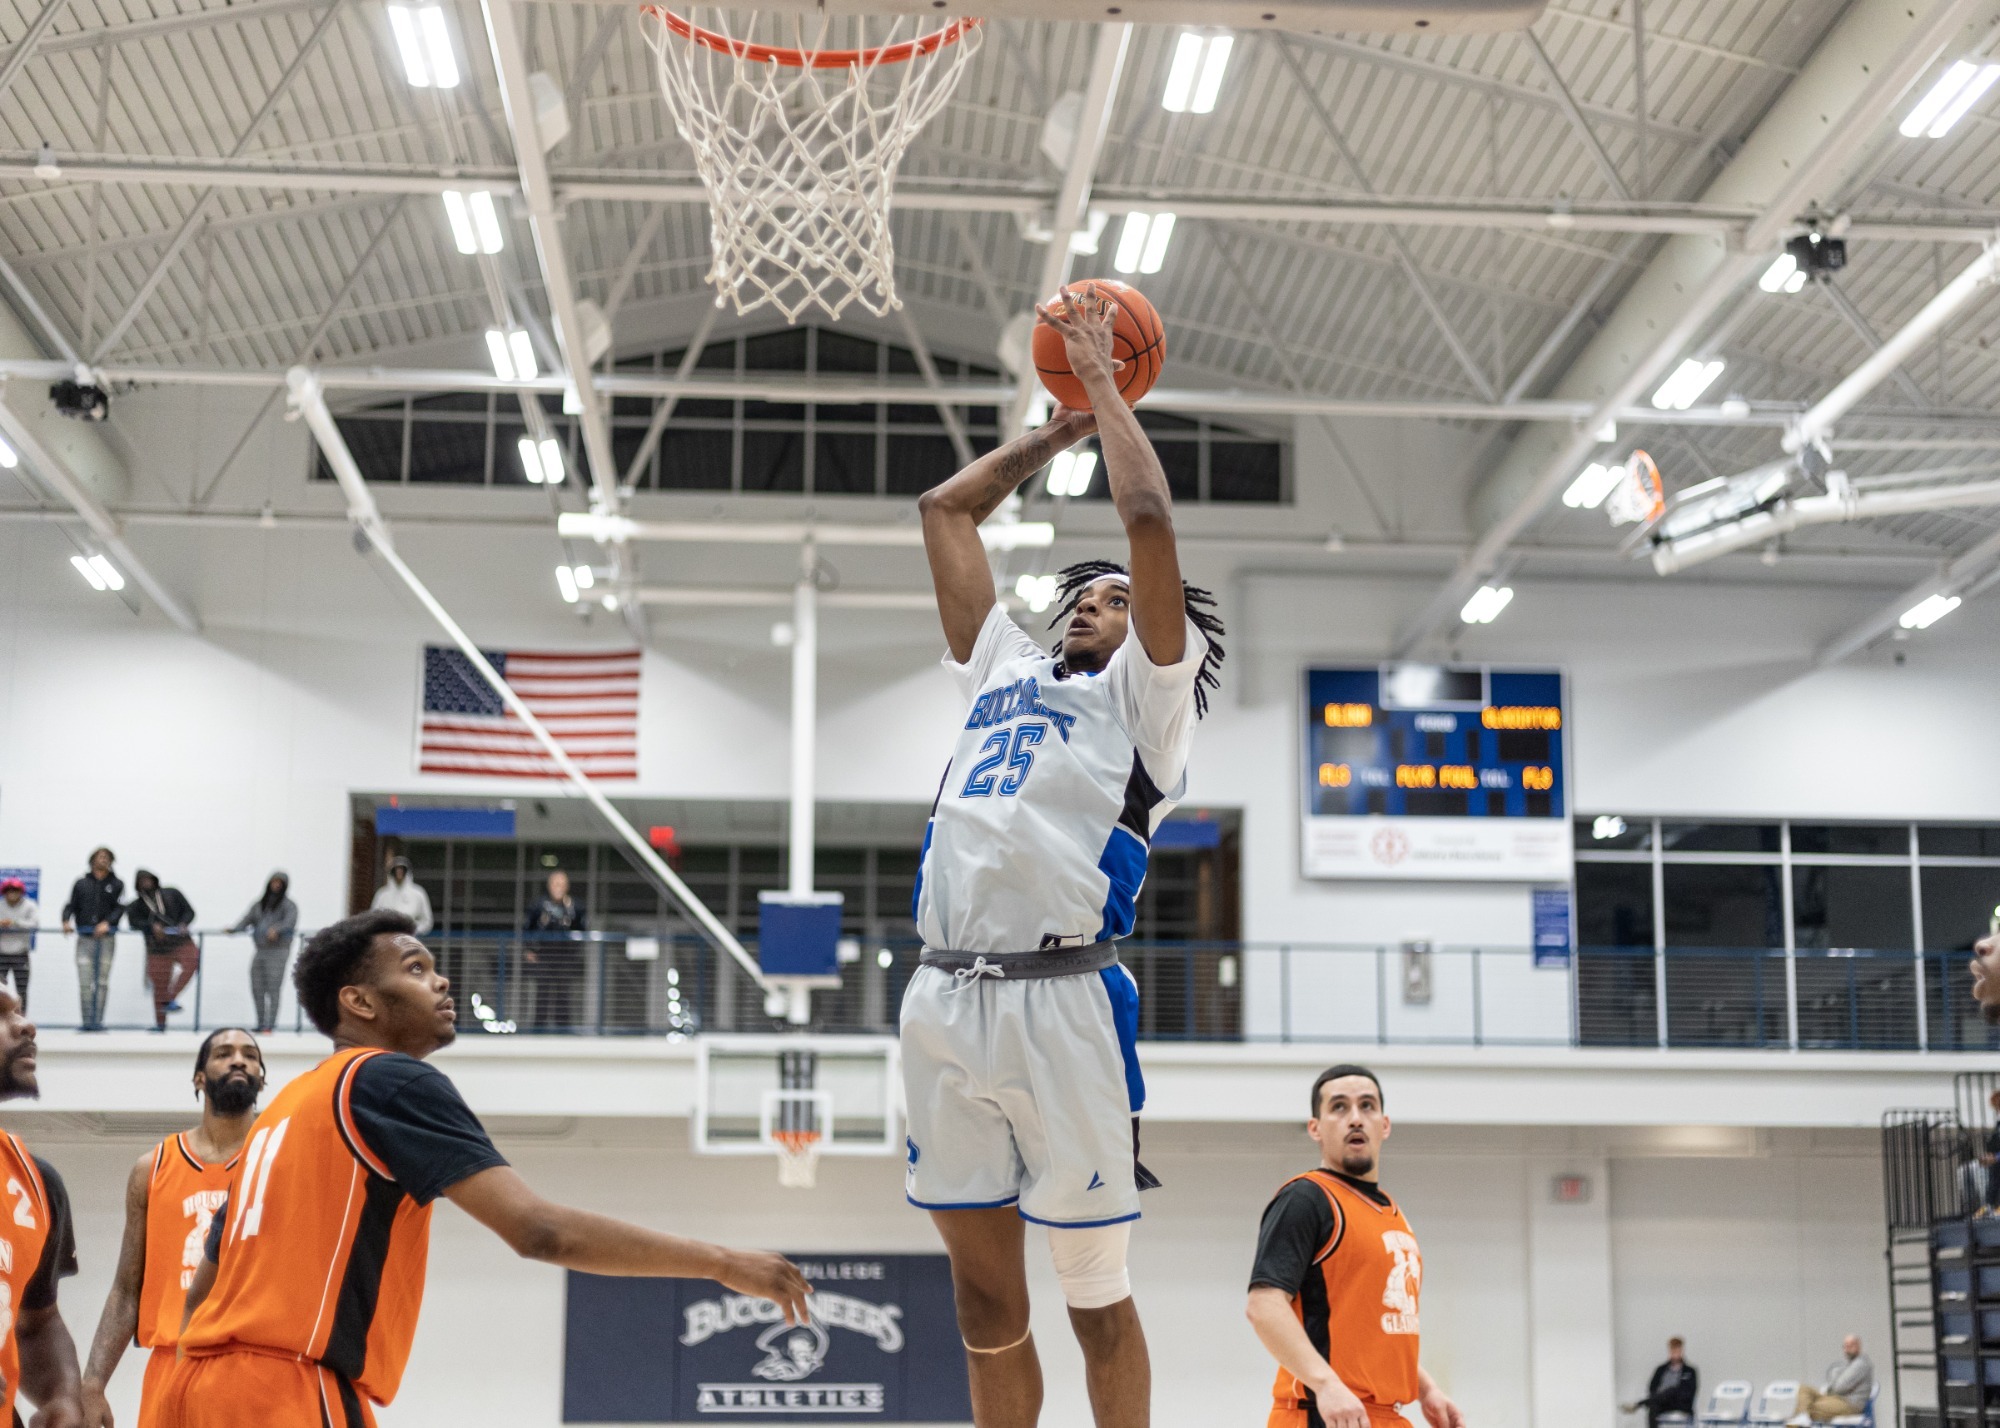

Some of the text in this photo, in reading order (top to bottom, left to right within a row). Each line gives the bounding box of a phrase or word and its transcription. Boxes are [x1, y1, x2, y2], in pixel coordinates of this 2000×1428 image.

[959, 723, 1049, 798] 25
[6, 1177, 36, 1230] 2
[229, 1116, 291, 1248] 11
[798, 1262, 886, 1280] OLLEGE
[679, 1291, 905, 1353] BUCCNEERS
[698, 1388, 884, 1409] ATHLETICS
